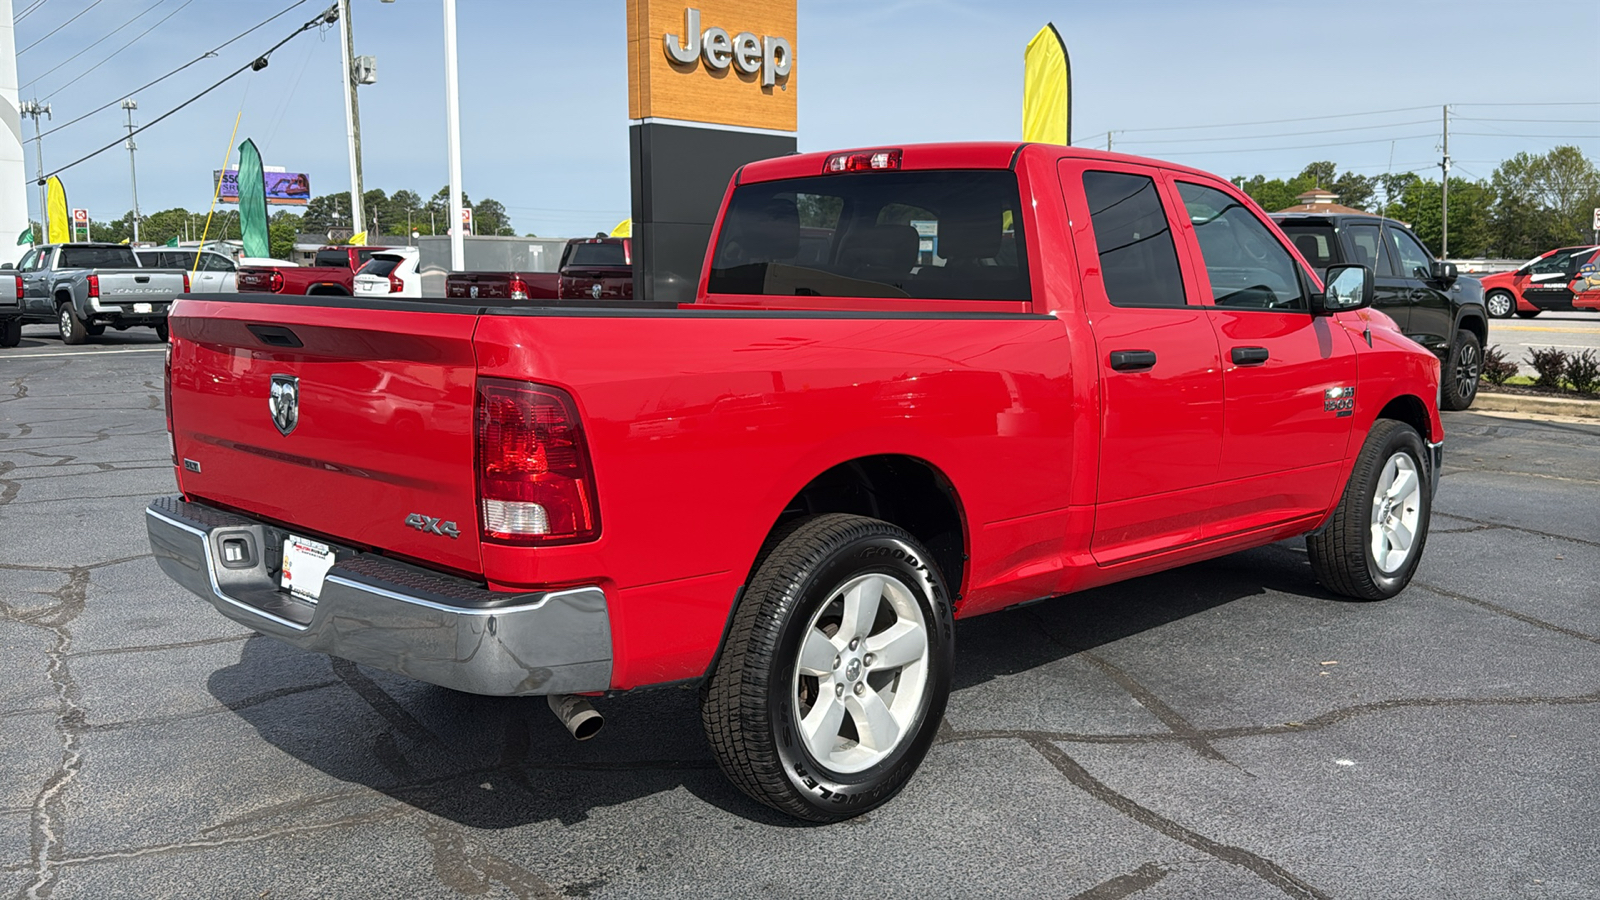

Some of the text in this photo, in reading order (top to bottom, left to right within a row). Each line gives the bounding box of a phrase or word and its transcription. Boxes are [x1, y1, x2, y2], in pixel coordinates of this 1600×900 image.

[663, 7, 792, 87] Jeep
[1324, 398, 1353, 411] 1500
[185, 460, 199, 471] SLT
[860, 547, 951, 641] GOODYEAR
